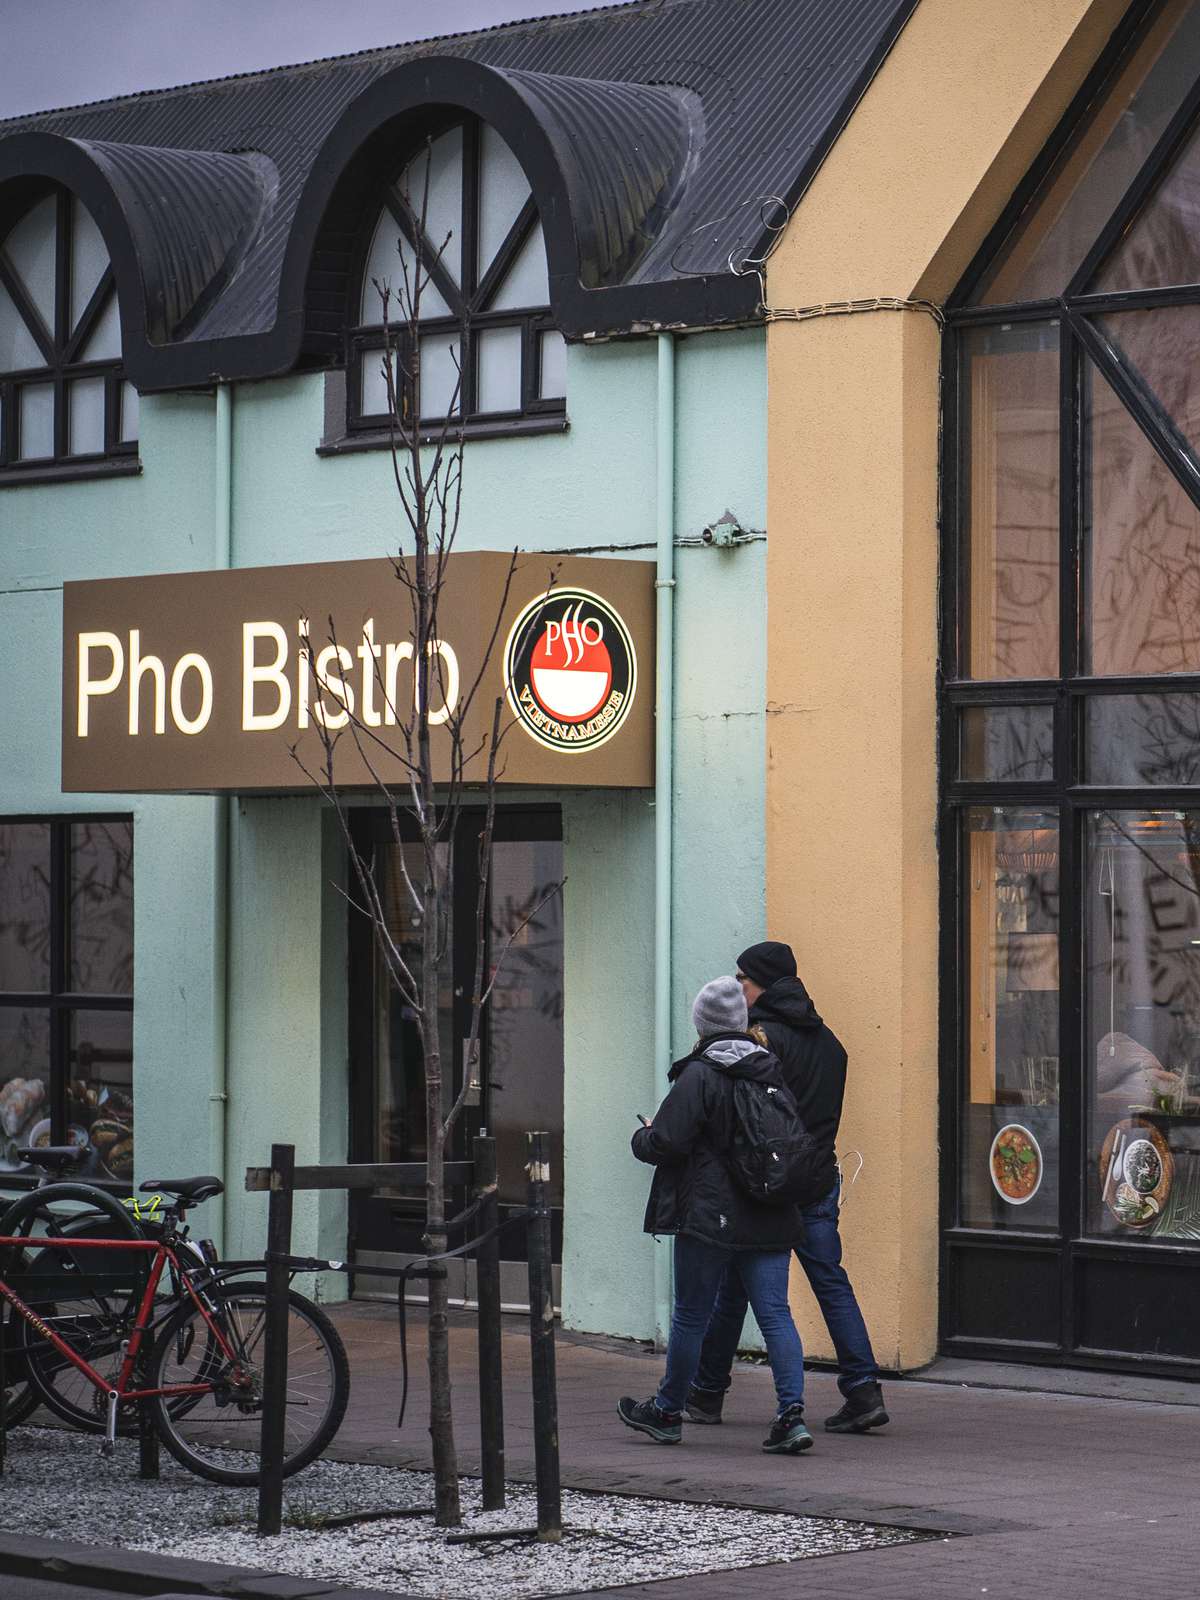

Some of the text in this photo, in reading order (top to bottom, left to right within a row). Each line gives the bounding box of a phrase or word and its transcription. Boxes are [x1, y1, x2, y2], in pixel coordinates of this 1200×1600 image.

[544, 600, 604, 668] PHO
[77, 617, 460, 738] Pho Bistro
[519, 683, 624, 741] VIETNAMESE
